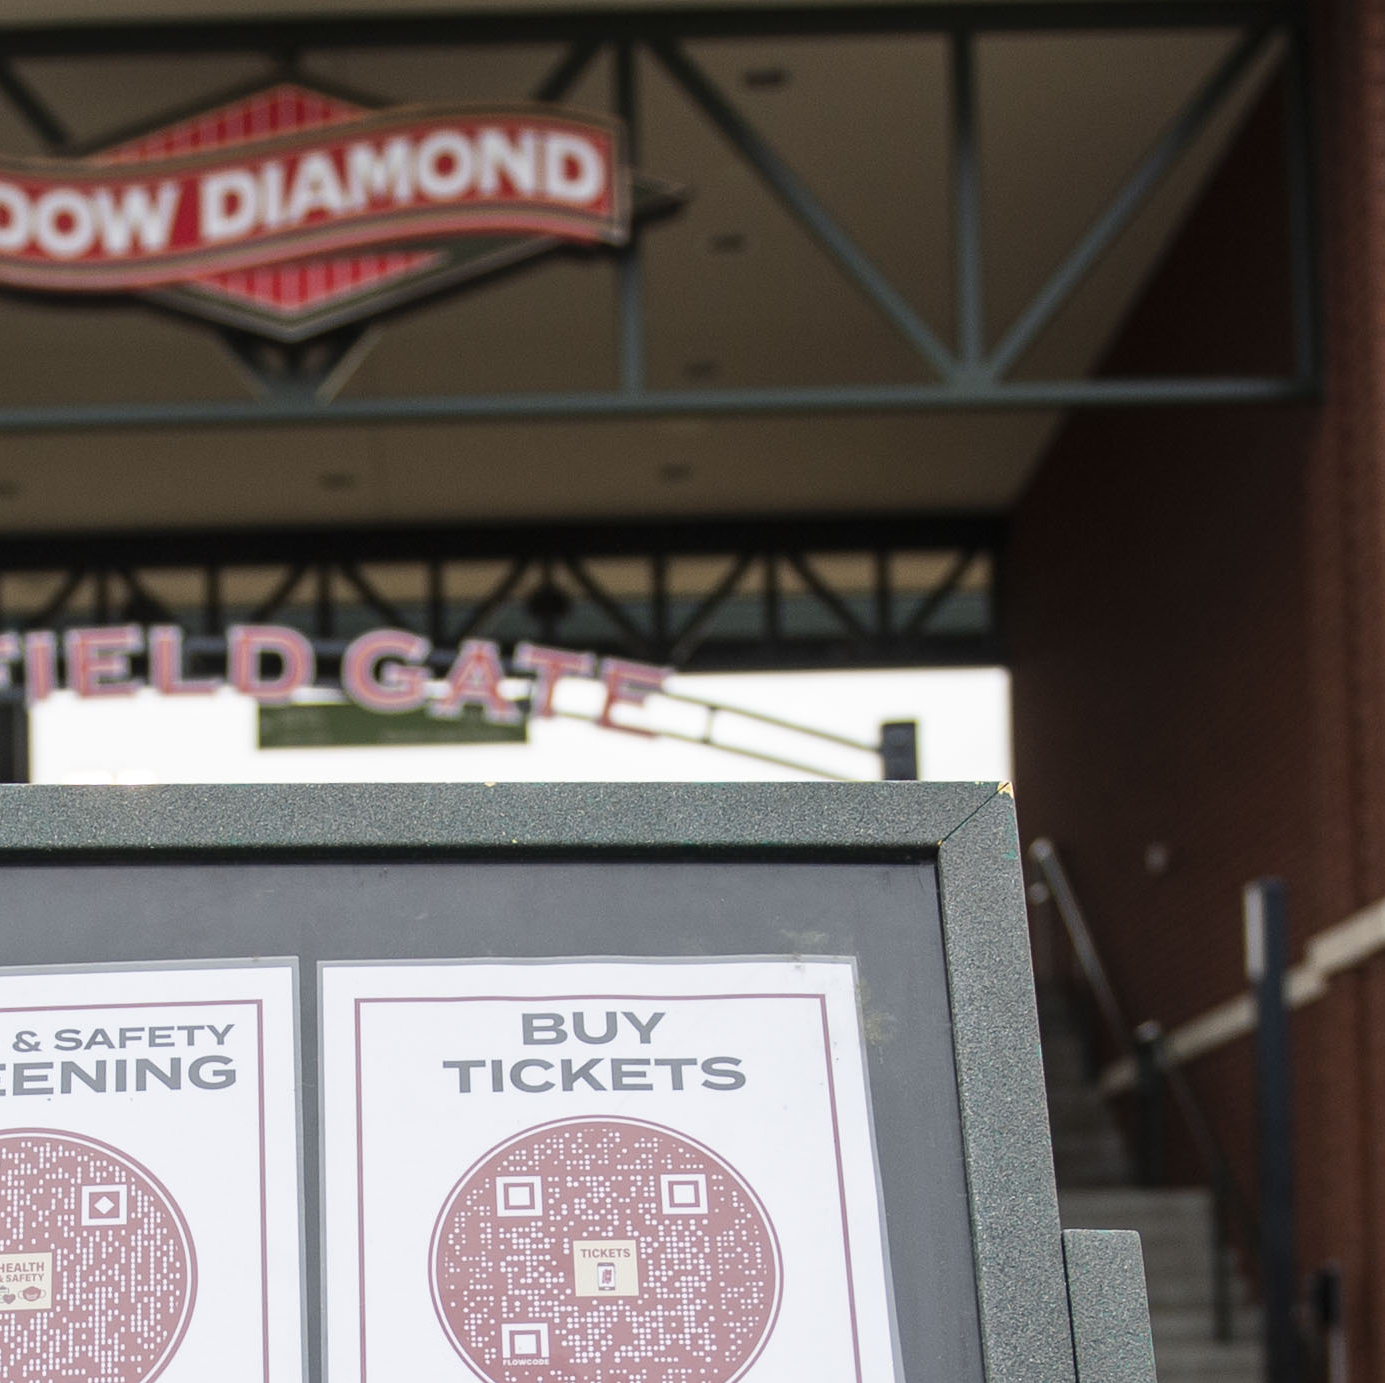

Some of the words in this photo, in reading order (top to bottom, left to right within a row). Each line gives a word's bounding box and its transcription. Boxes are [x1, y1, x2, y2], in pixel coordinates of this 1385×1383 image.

[199, 128, 607, 244] DIAMOND
[342, 627, 669, 740] GATE
[11, 1031, 42, 1053] &
[53, 1023, 237, 1051] SAFETY
[521, 1011, 667, 1046] BUY
[443, 1056, 747, 1094] TICKETS
[580, 1248, 631, 1259] TICKETS
[6, 1273, 45, 1283] SAFETY
[503, 1358, 550, 1366] FLOWCODE
